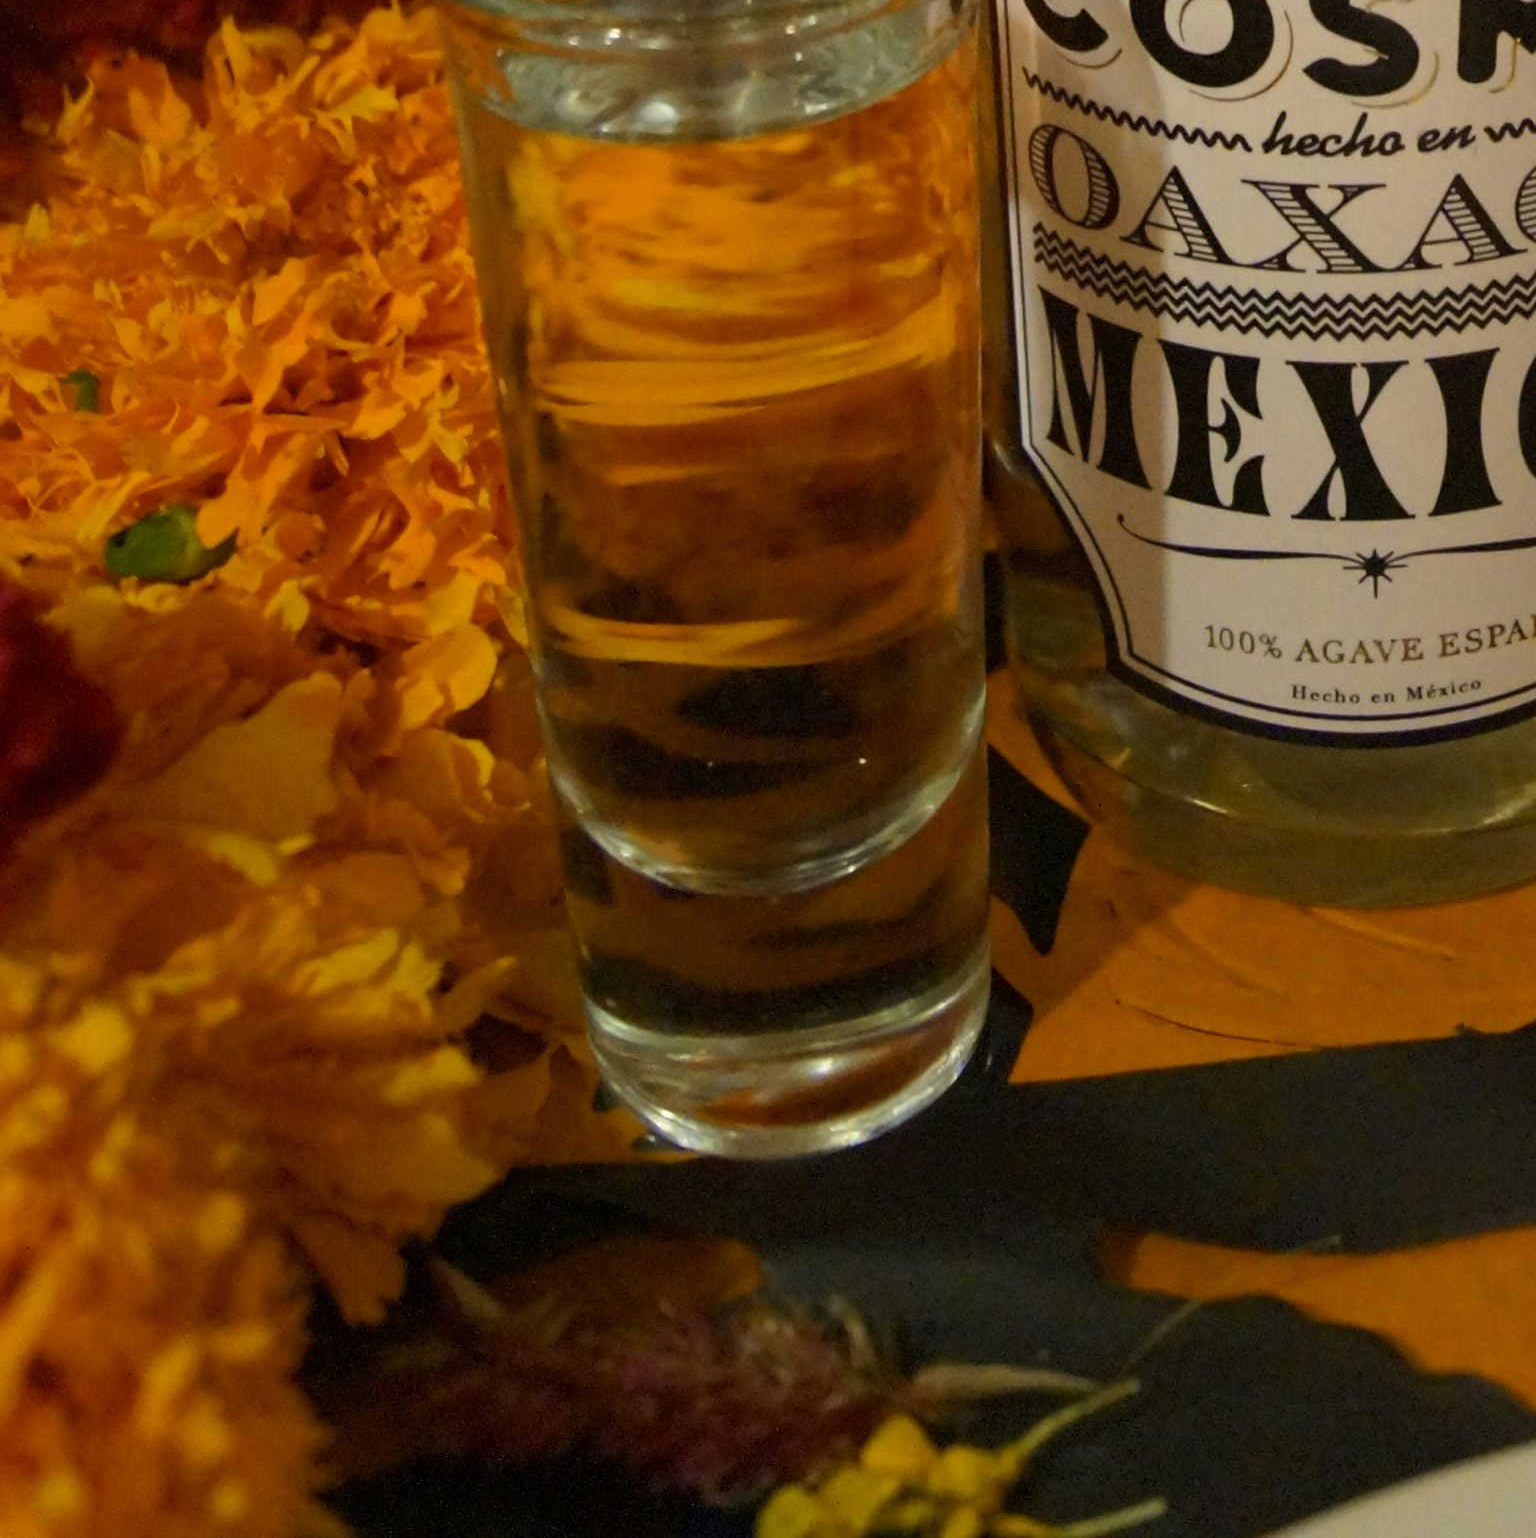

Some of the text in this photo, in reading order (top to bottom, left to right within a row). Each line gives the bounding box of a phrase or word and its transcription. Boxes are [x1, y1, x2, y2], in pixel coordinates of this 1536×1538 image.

[1261, 111, 1478, 158] hecho en
[1204, 624, 1283, 659] 100%
[1294, 636, 1425, 665] AGAVE
[1291, 677, 1482, 705] Hecho en México
